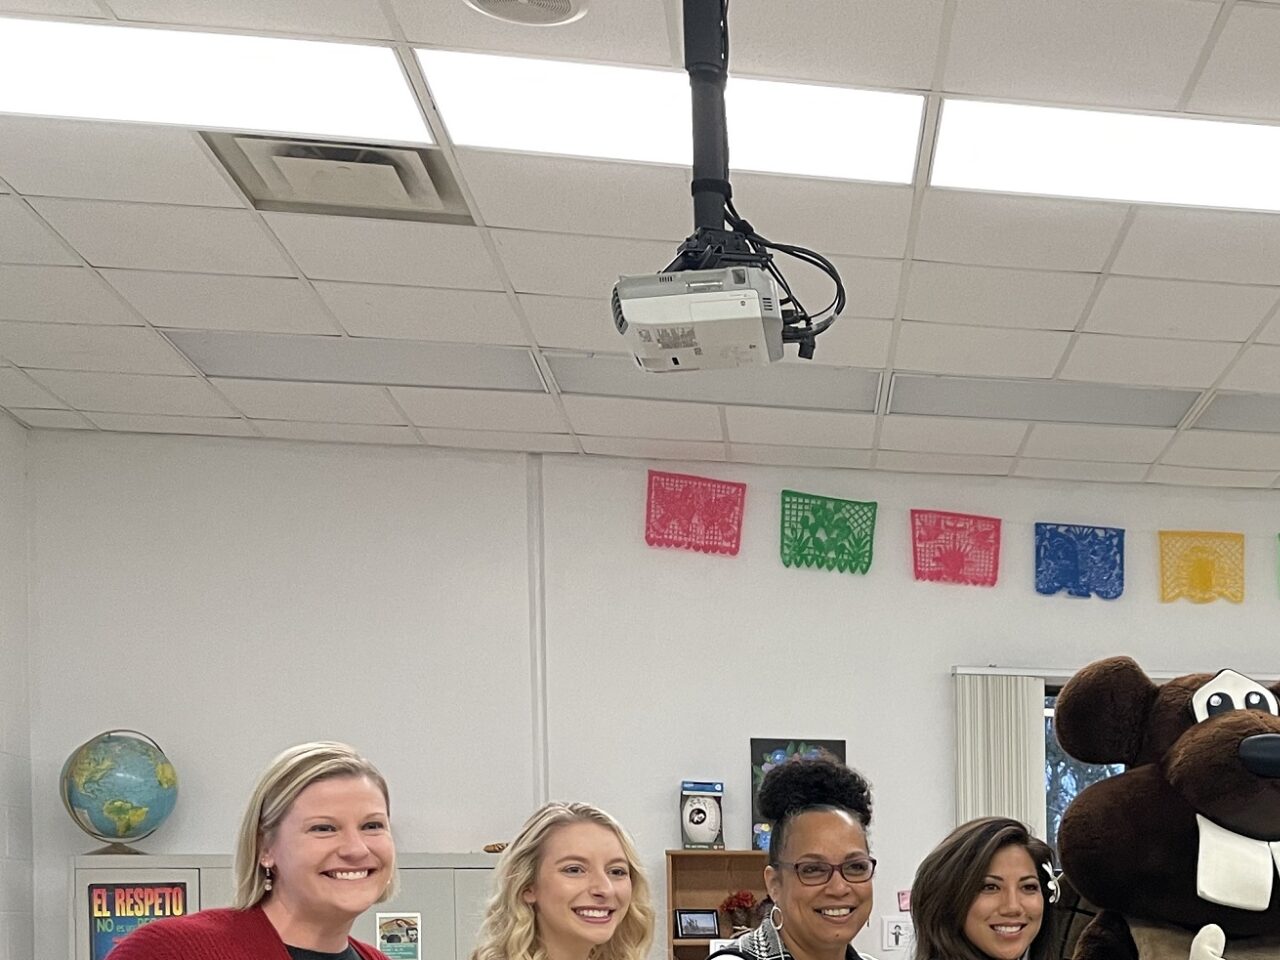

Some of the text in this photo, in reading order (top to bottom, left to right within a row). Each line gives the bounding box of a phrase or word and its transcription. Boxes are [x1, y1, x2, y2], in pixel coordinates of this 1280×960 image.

[93, 887, 183, 917] EL RESPETO
[96, 918, 114, 933] NO
